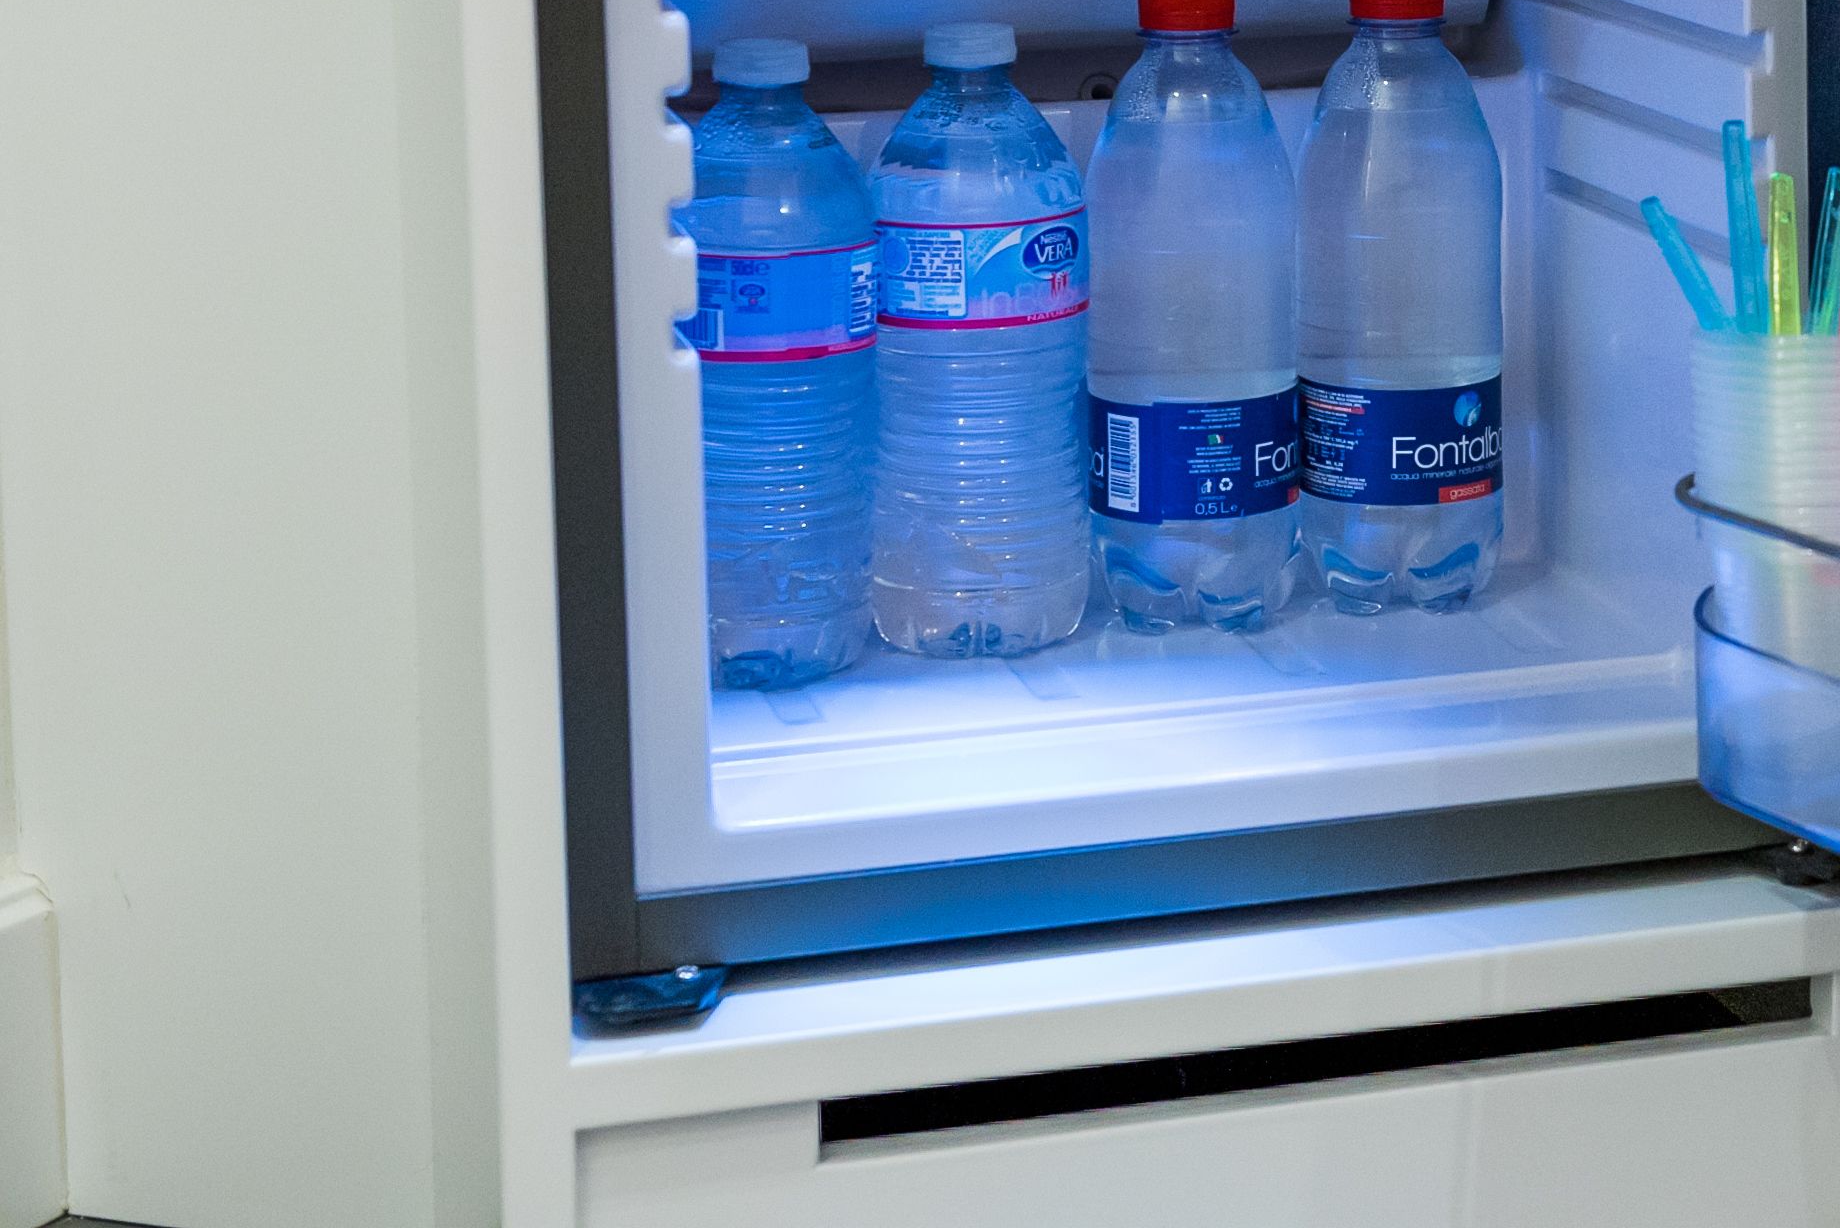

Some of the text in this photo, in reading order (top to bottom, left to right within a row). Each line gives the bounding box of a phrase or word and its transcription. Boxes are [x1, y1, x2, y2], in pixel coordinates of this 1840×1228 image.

[1034, 237, 1073, 263] VERA
[1390, 472, 1419, 481] acqua
[1450, 483, 1485, 501] gassata
[1195, 502, 1218, 516] 0,5
